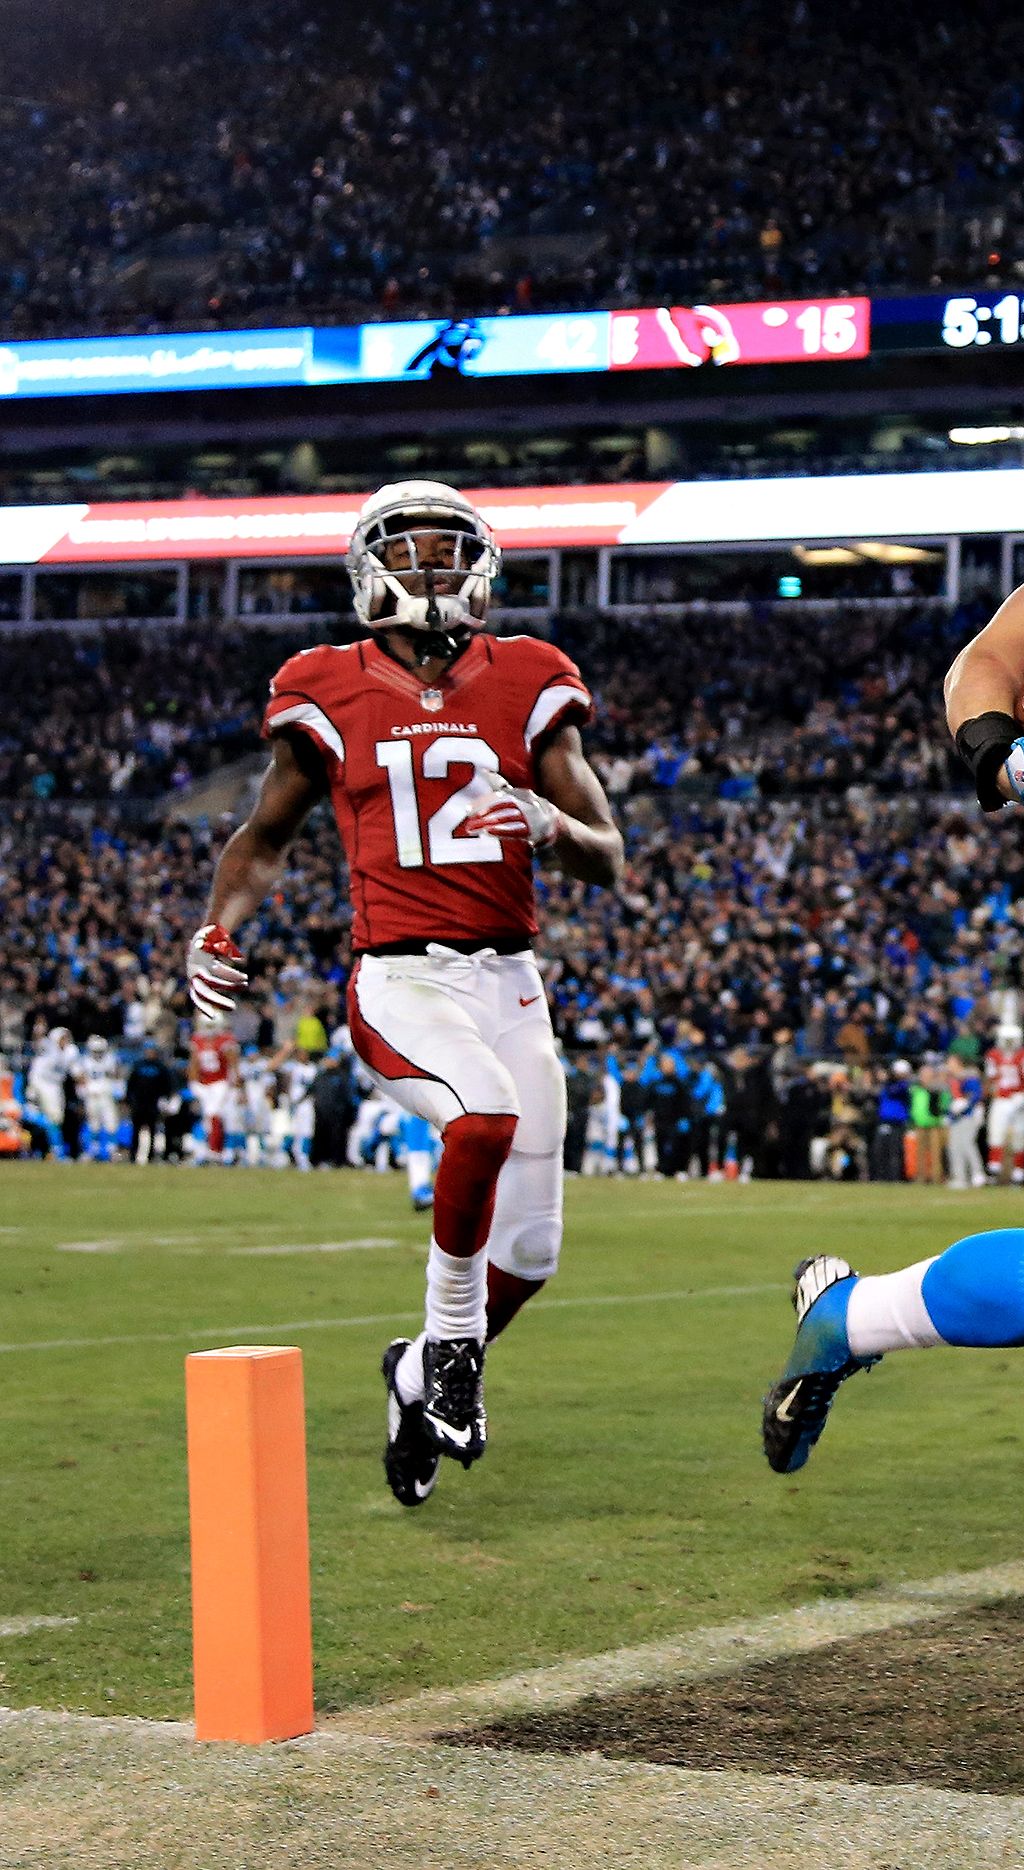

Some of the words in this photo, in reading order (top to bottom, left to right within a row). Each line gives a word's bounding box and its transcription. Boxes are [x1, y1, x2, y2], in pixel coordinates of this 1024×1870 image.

[796, 305, 857, 354] 15
[391, 722, 478, 736] CARDINALS
[375, 736, 504, 869] 12
